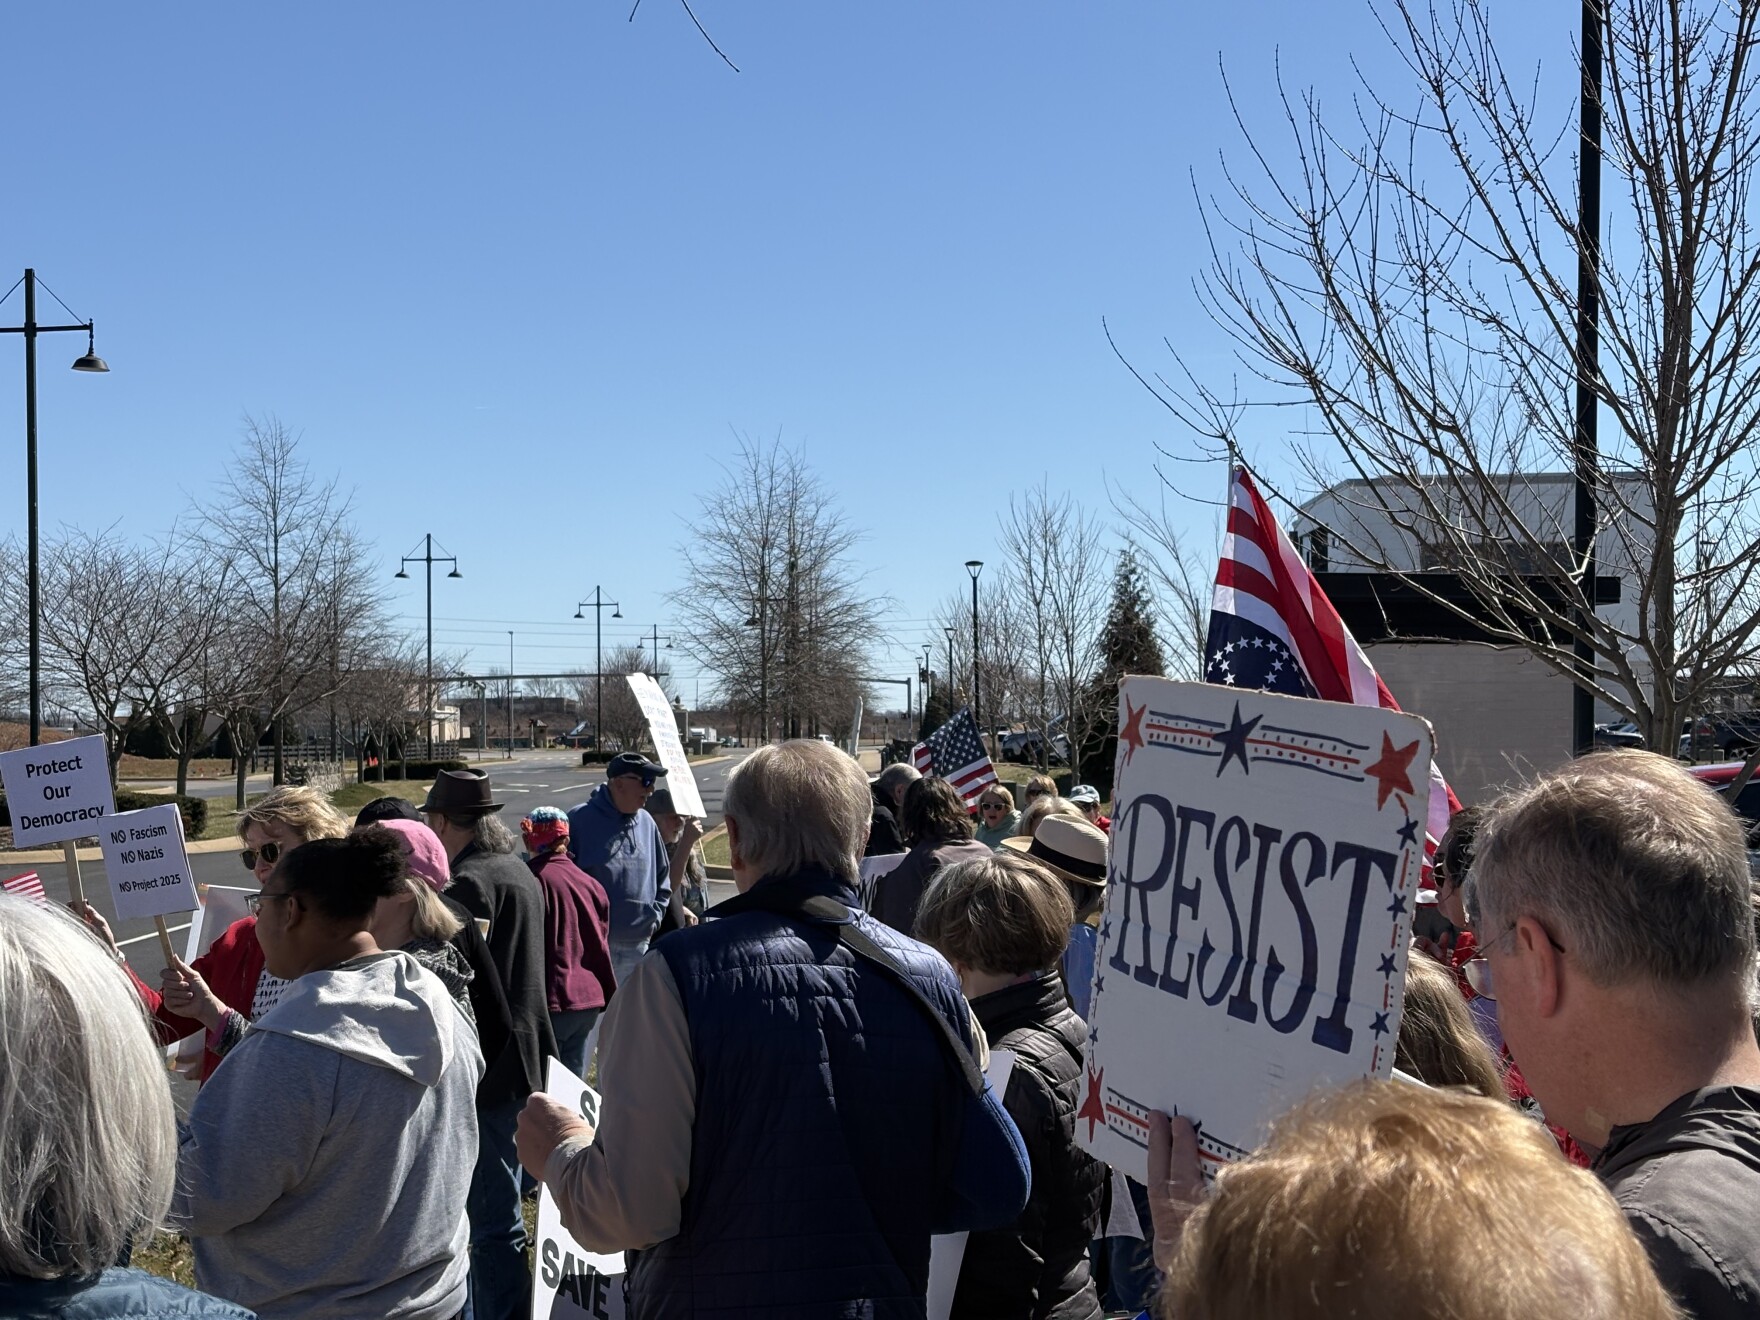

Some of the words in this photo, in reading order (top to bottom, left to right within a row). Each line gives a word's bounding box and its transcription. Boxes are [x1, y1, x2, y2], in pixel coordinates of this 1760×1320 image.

[26, 756, 83, 778] Protect
[43, 785, 71, 800] Our
[21, 805, 104, 830] Democracy
[111, 830, 126, 844] NO
[130, 825, 167, 841] Fascism
[121, 850, 136, 864] NO
[137, 846, 164, 861] Nazis
[132, 878, 159, 892] Project
[160, 874, 181, 887] 2025
[1109, 793, 1398, 1054] RESIST
[541, 1237, 611, 1320] SAVE
